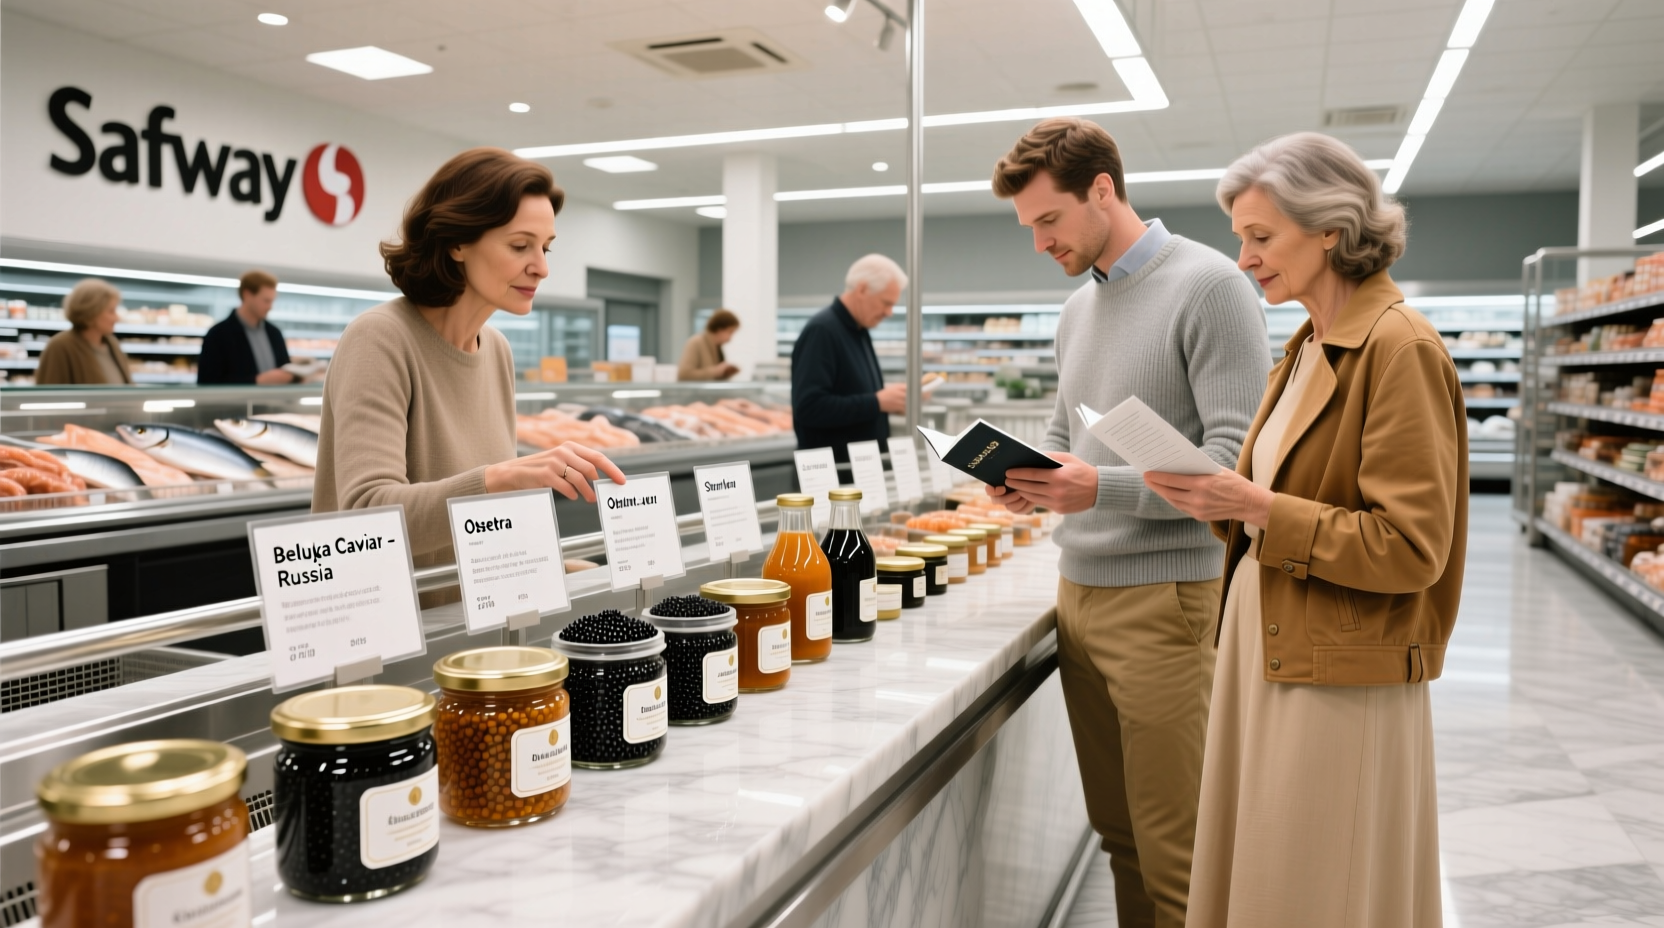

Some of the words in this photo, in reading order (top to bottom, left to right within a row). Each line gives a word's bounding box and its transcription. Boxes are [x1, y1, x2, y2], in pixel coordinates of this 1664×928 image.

[48, 86, 298, 222] Safway
[334, 533, 383, 555] Caviar
[277, 563, 334, 588] Russia
